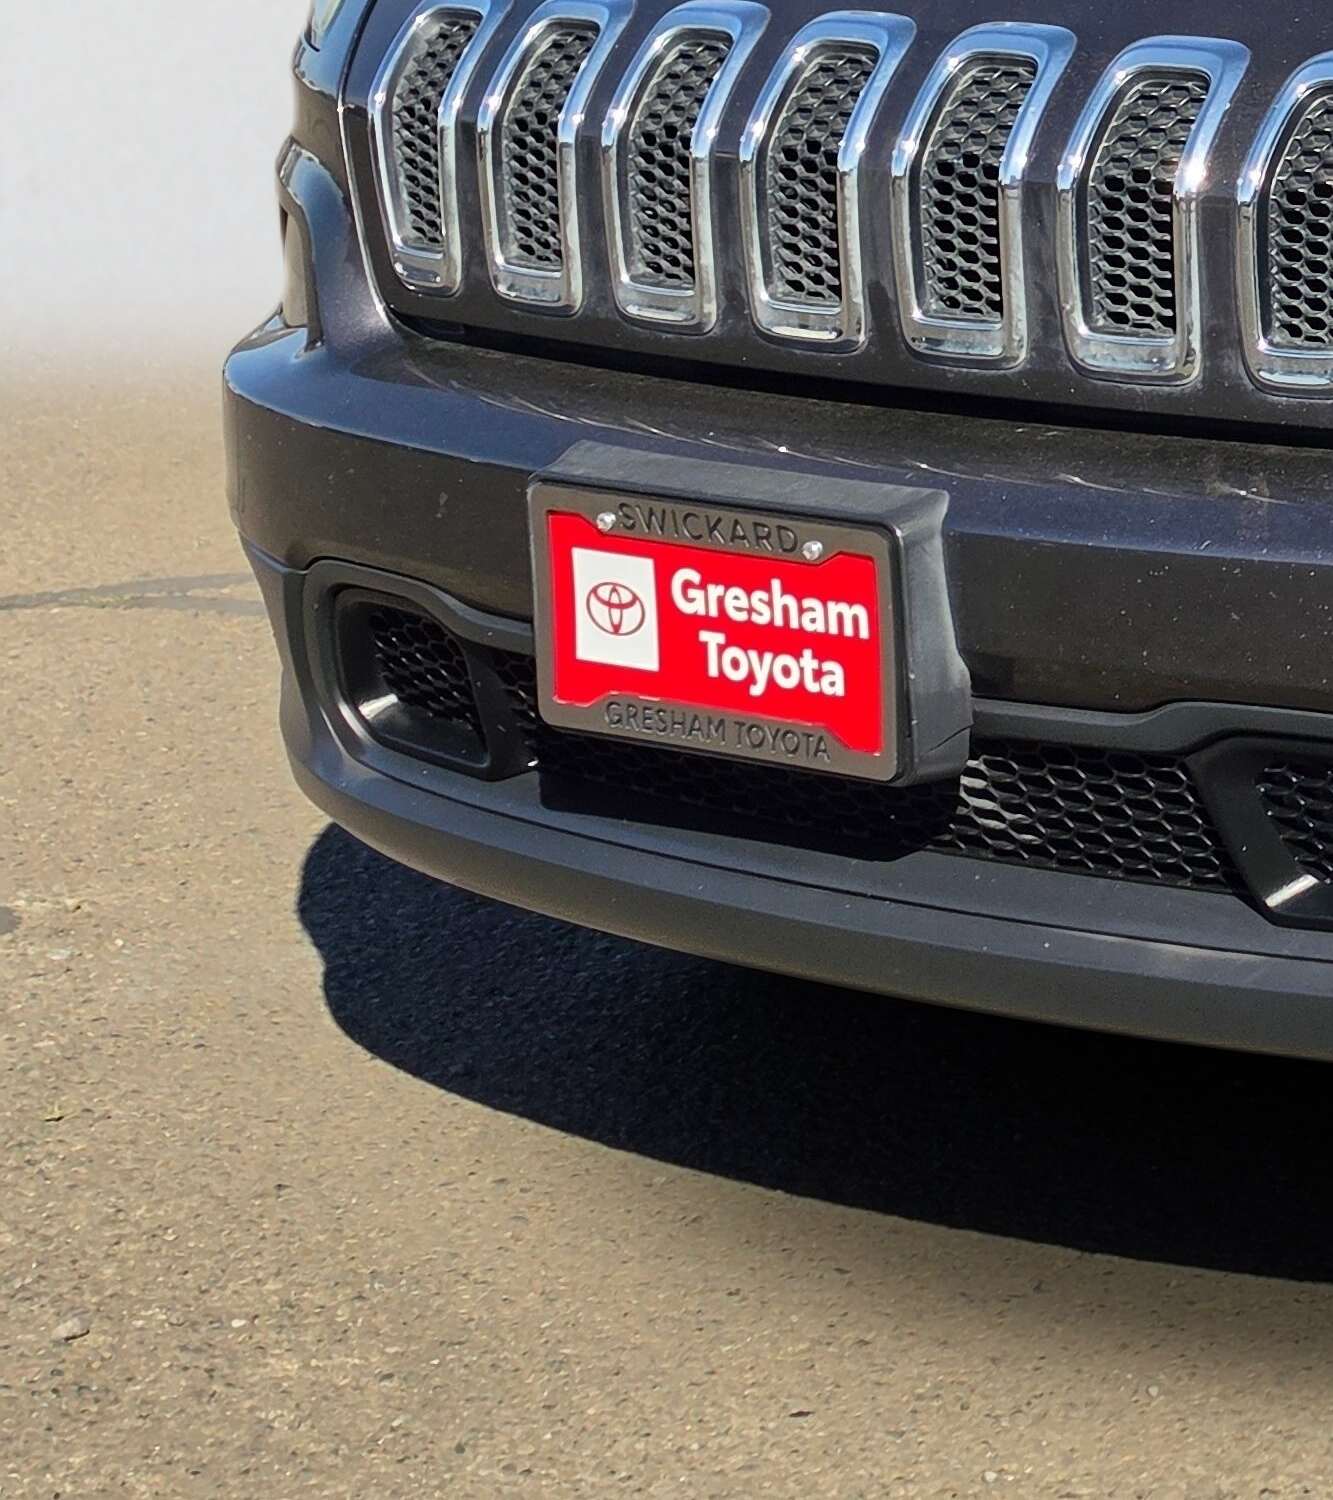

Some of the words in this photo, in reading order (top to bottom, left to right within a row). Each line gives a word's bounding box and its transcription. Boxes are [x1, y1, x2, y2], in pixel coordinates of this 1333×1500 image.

[617, 502, 800, 553] SWICKARD
[671, 568, 869, 639] Gresham
[699, 630, 846, 697] Toyota
[605, 701, 726, 745] GRESHAM
[734, 721, 831, 762] TOYOTA
